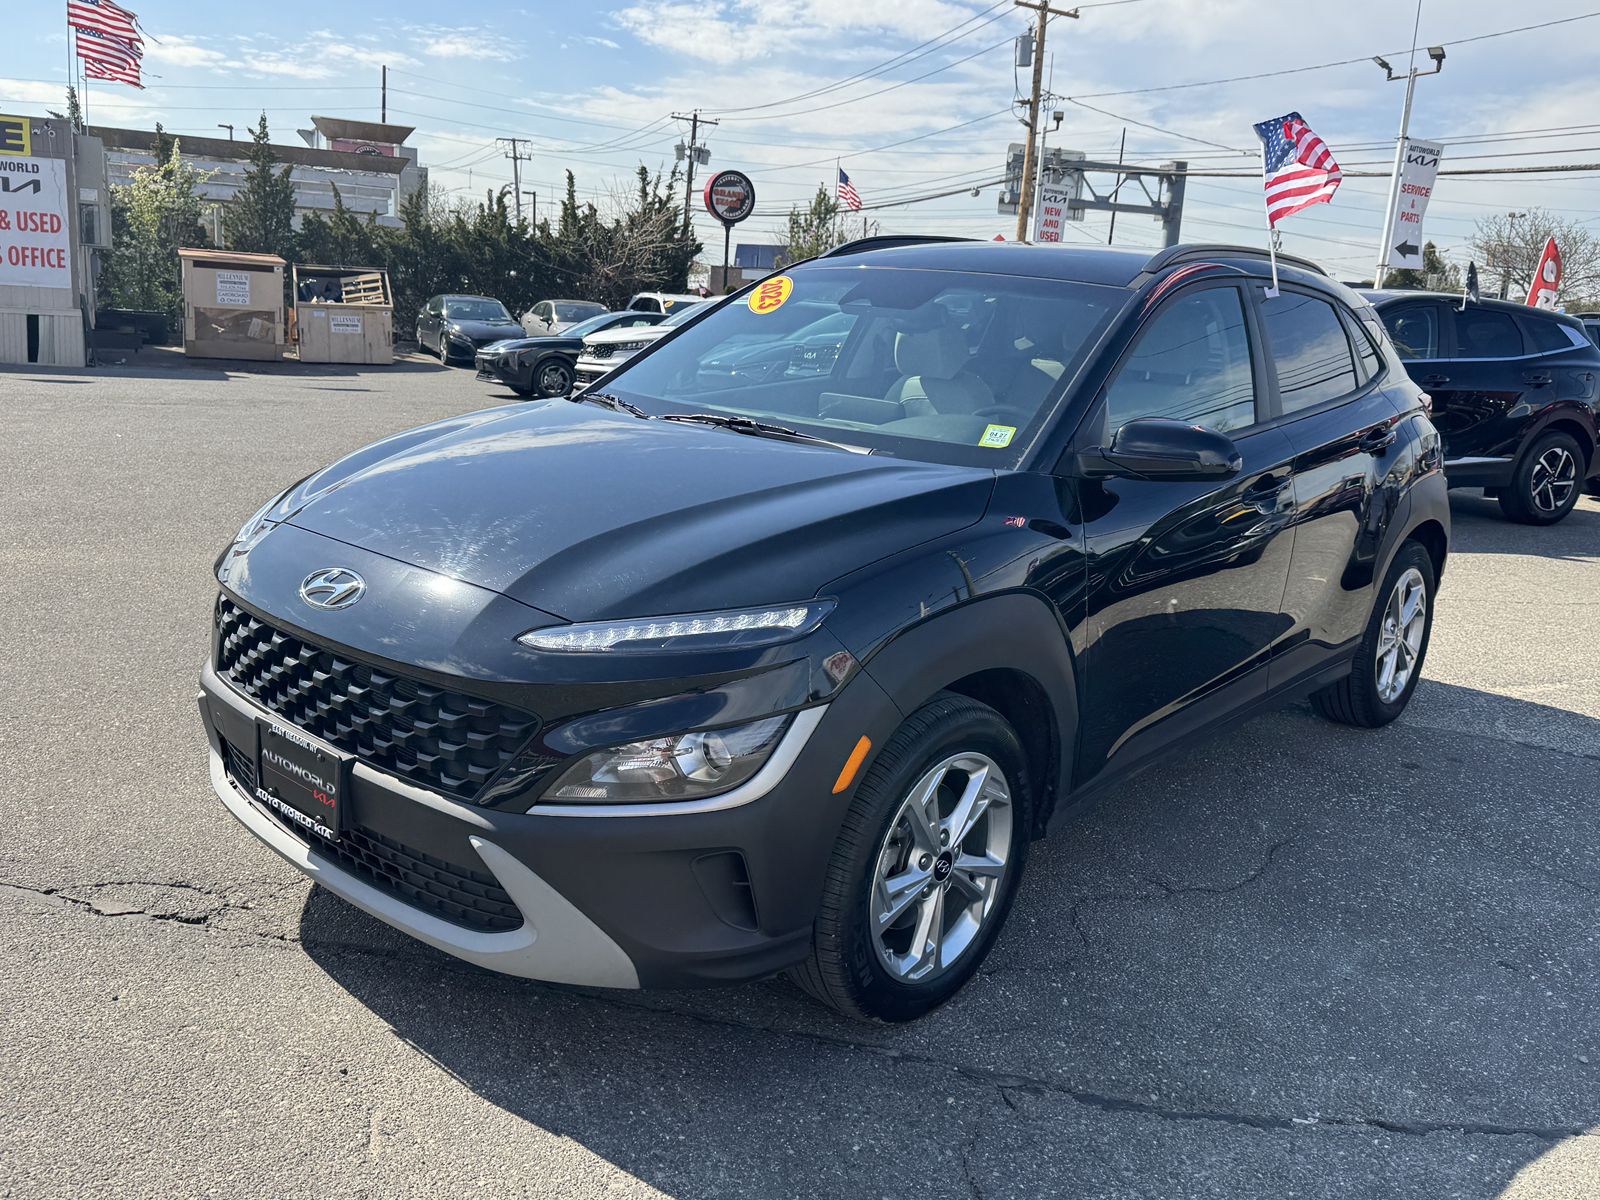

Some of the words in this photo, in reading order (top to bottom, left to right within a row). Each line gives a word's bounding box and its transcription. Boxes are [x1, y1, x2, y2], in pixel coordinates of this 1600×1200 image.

[1409, 144, 1441, 157] AUTOWORLD
[713, 188, 745, 200] GRAND
[1044, 188, 1068, 196] AUTOWORLD
[1401, 183, 1431, 198] SERVICE
[1410, 199, 1416, 209] &
[1044, 206, 1062, 217] NEW
[1400, 211, 1420, 224] PARTS
[16, 210, 62, 234] USED
[1043, 218, 1059, 229] AND
[1040, 230, 1060, 242] USED
[8, 245, 67, 269] OFFICE
[757, 279, 784, 311] 2023
[272, 724, 285, 737] EAST
[309, 744, 318, 753] NY
[262, 748, 336, 795] AUTOWORLD
[313, 789, 336, 808] KIA
[256, 787, 279, 808] AUTO
[279, 802, 312, 828] WORLD
[313, 822, 333, 840] KIA
